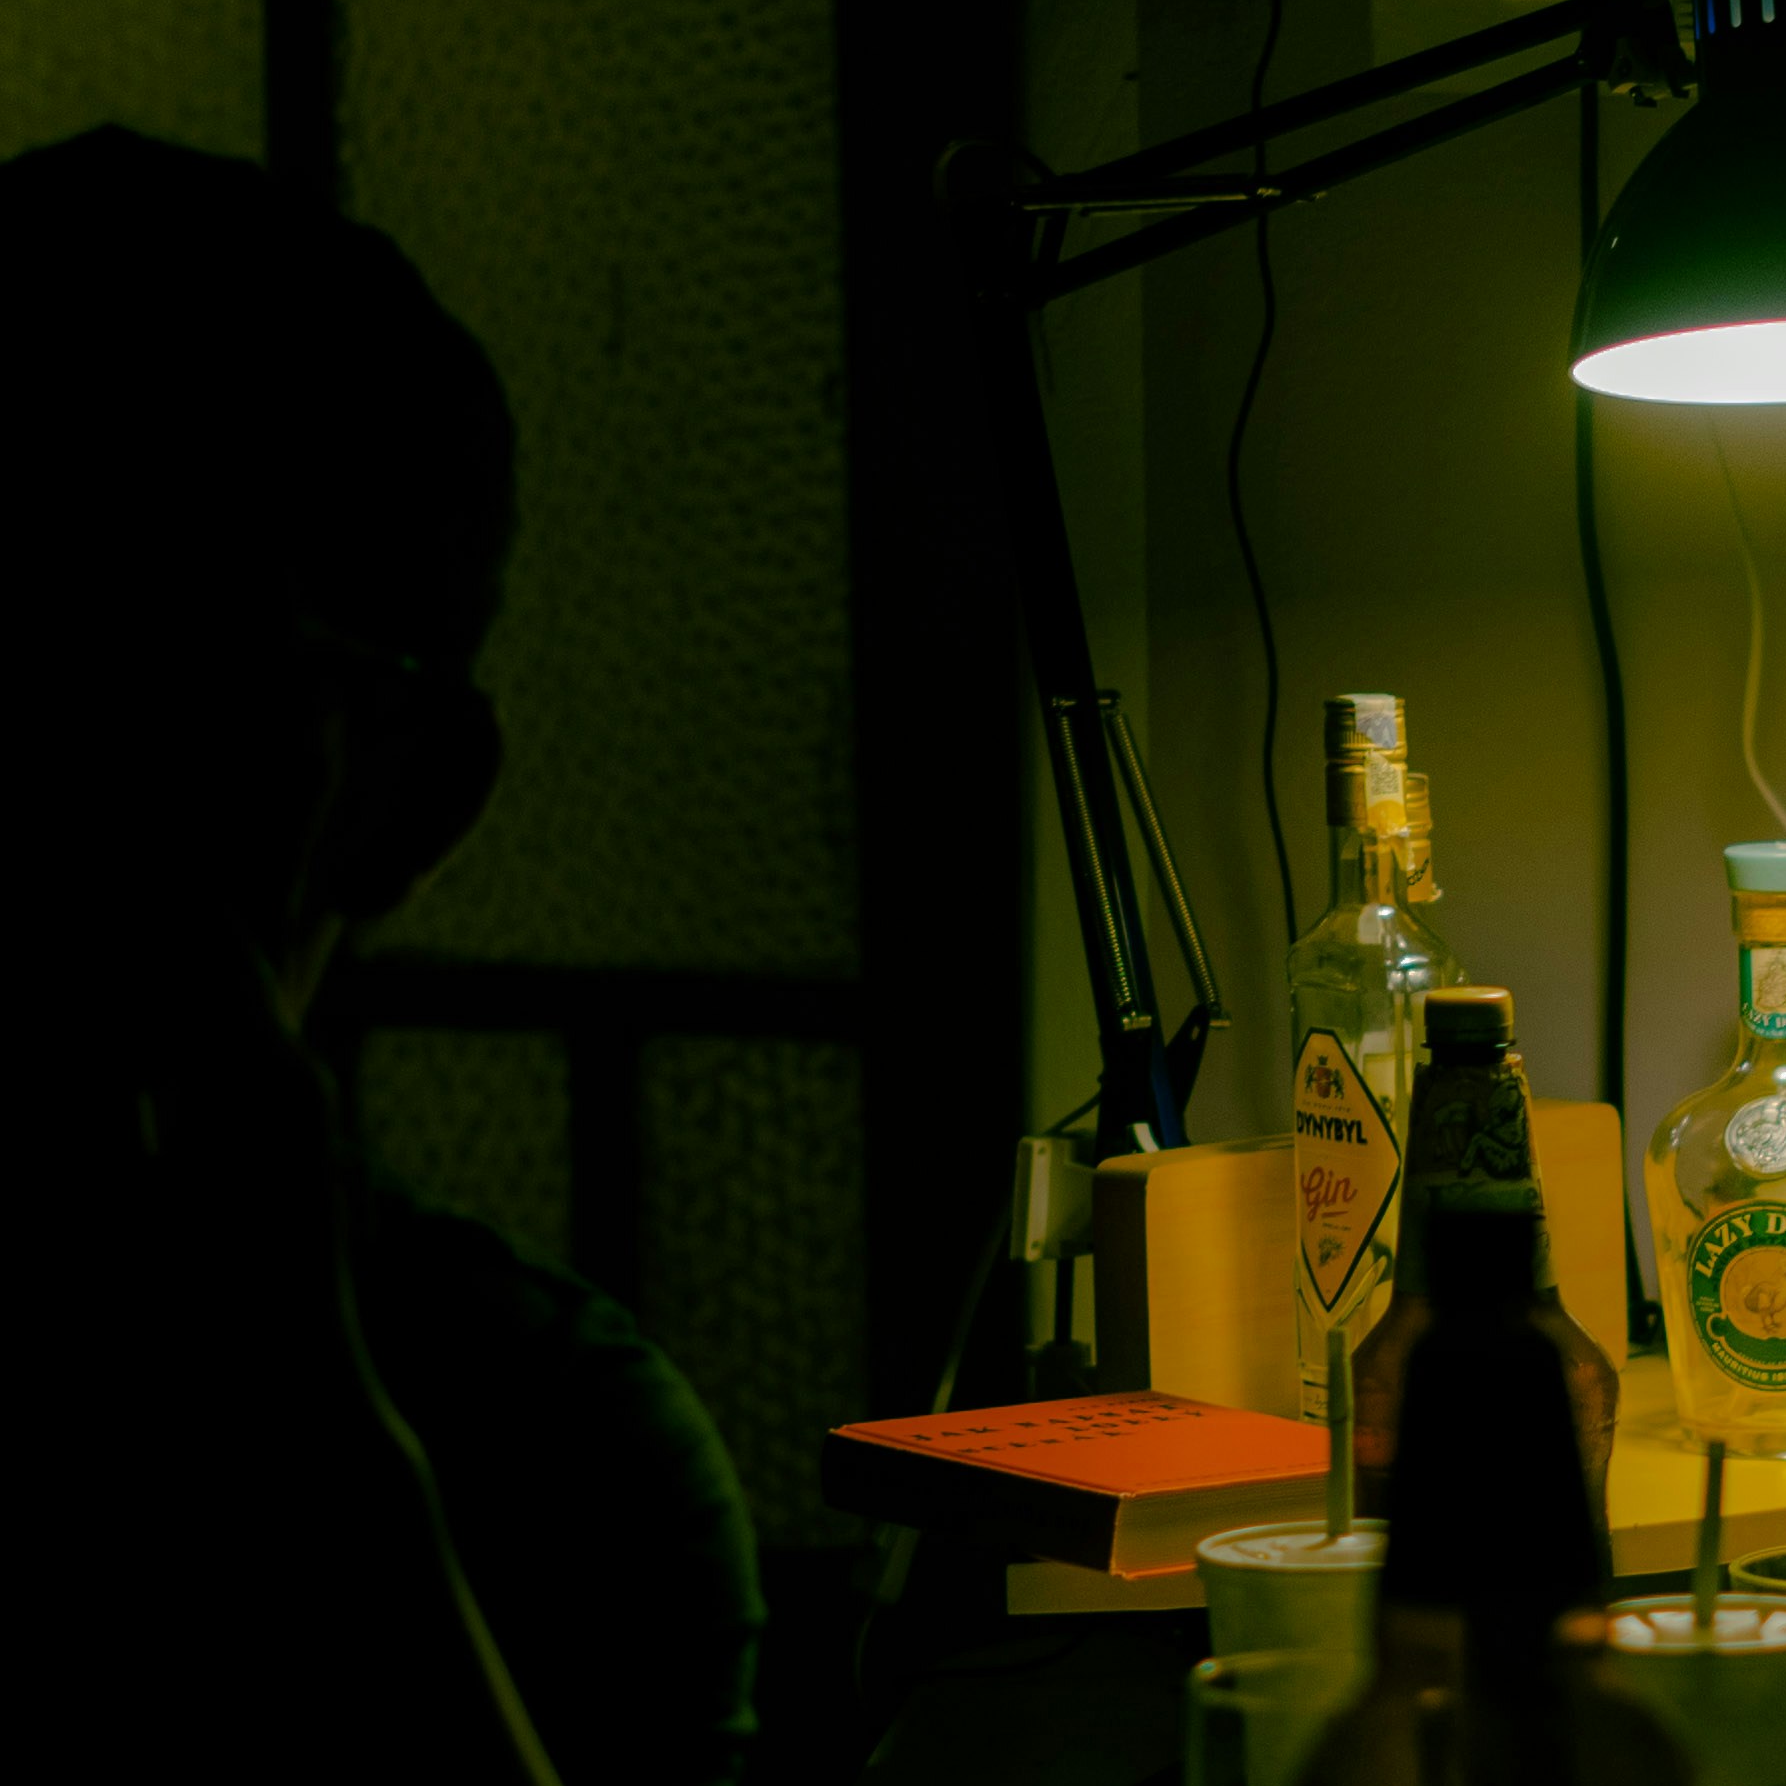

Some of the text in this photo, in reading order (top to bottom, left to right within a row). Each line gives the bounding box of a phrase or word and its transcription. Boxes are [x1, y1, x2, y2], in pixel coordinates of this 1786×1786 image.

[1296, 1109, 1368, 1145] DYNYBYL
[1300, 1165, 1359, 1223] Gin
[1695, 1213, 1754, 1279] LAZY
[1711, 1342, 1770, 1382] MAURITIUS
